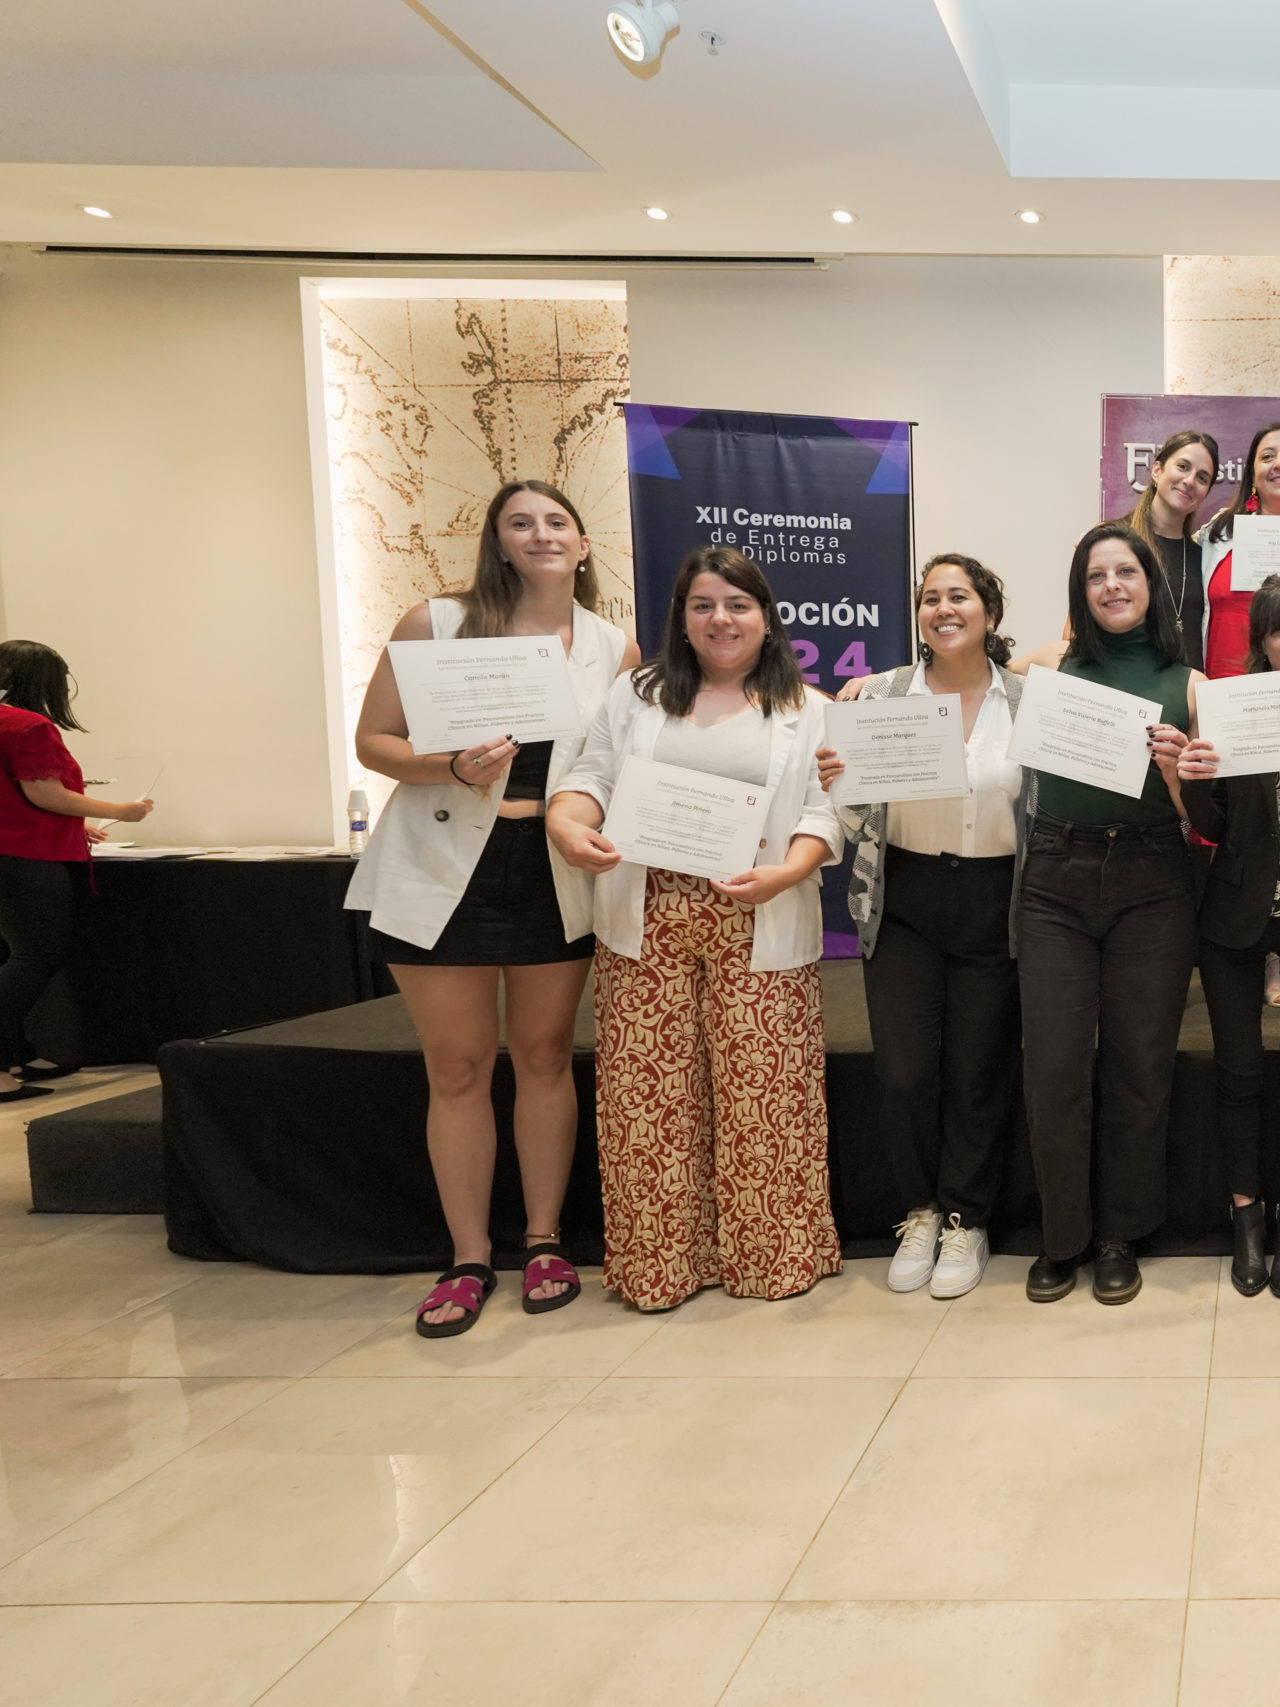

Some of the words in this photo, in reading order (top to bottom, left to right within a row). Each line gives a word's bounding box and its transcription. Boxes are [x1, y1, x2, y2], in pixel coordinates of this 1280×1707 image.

[695, 505, 728, 525] XII
[733, 508, 852, 530] Ceremonia
[710, 528, 737, 544] de
[748, 529, 840, 550] Entrega
[742, 545, 847, 565] Diplomas
[776, 597, 880, 628] OCIÓN
[791, 639, 872, 684] 24
